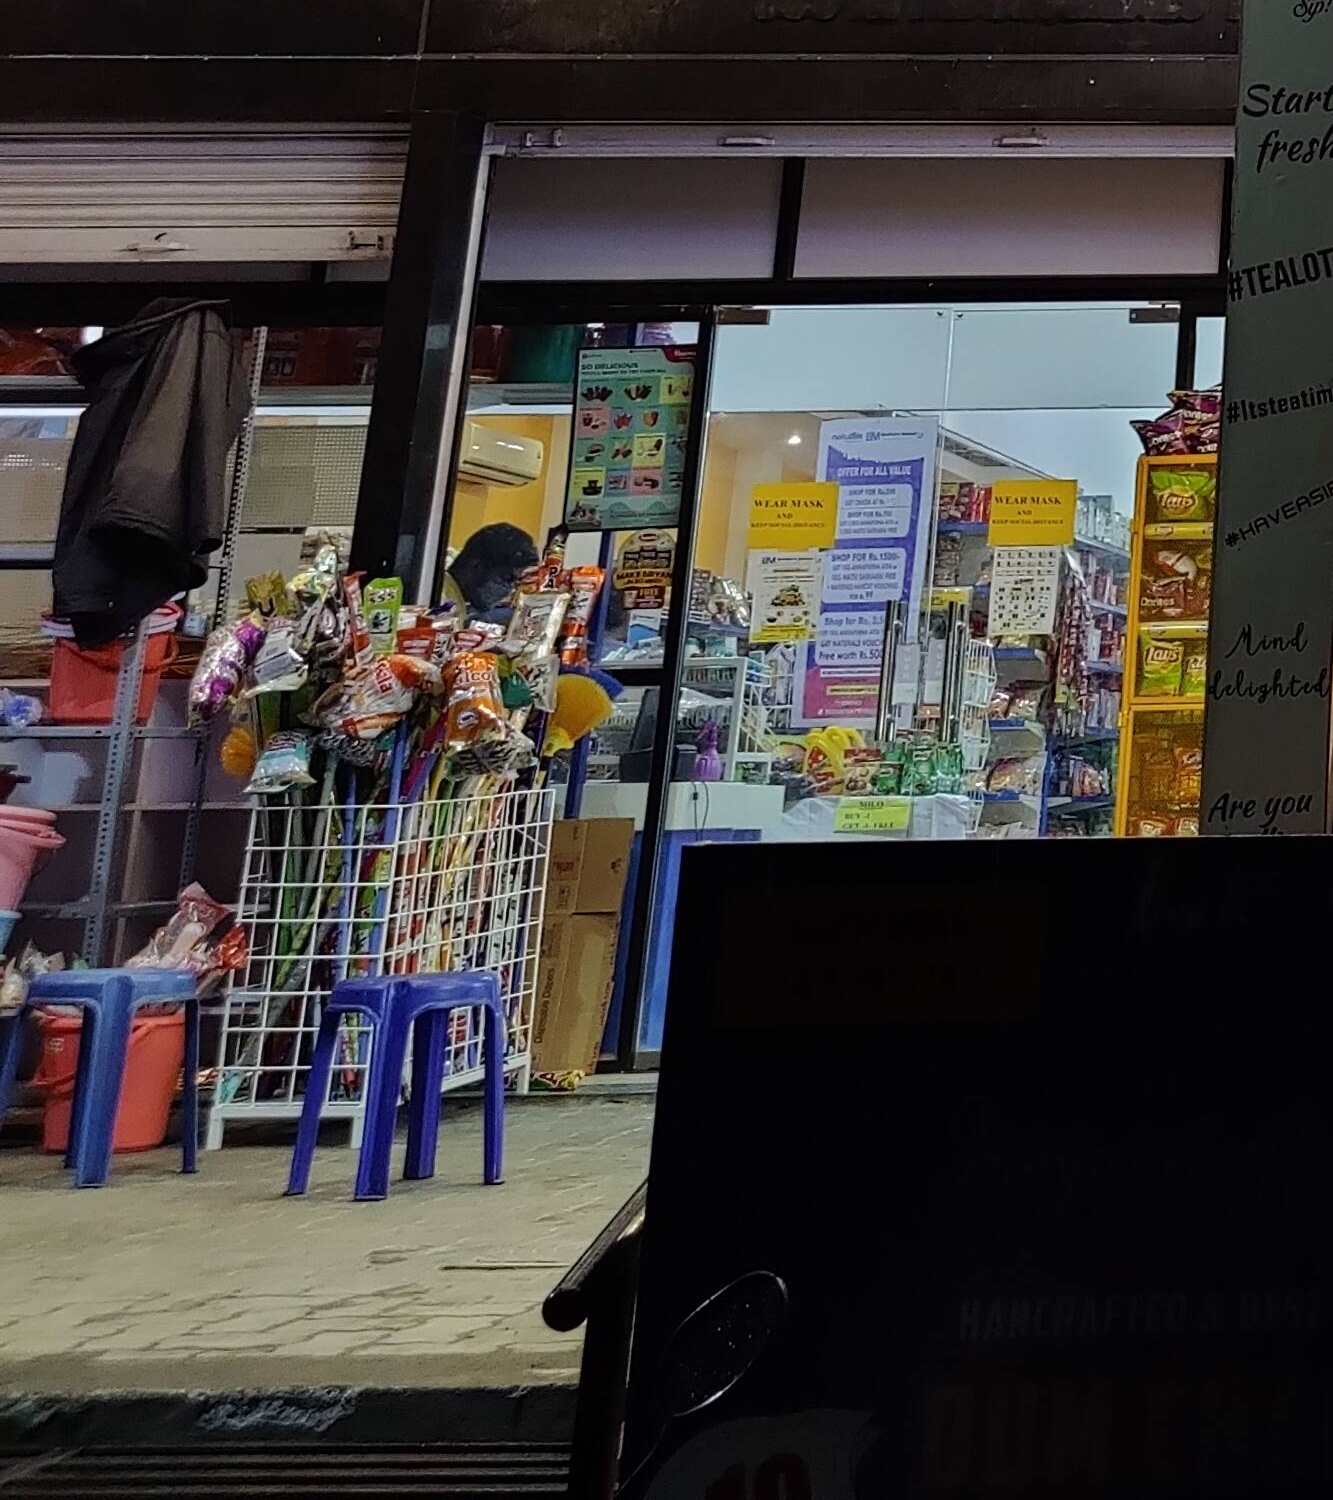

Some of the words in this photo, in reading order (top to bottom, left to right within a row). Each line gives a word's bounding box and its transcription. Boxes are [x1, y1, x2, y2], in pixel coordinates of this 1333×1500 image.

[754, 500, 788, 508] WEAR
[792, 500, 825, 508] MASK
[1225, 622, 1308, 659] Mind
[1209, 668, 1331, 704] delighted
[1208, 793, 1255, 823] Are
[1259, 793, 1313, 828] you
